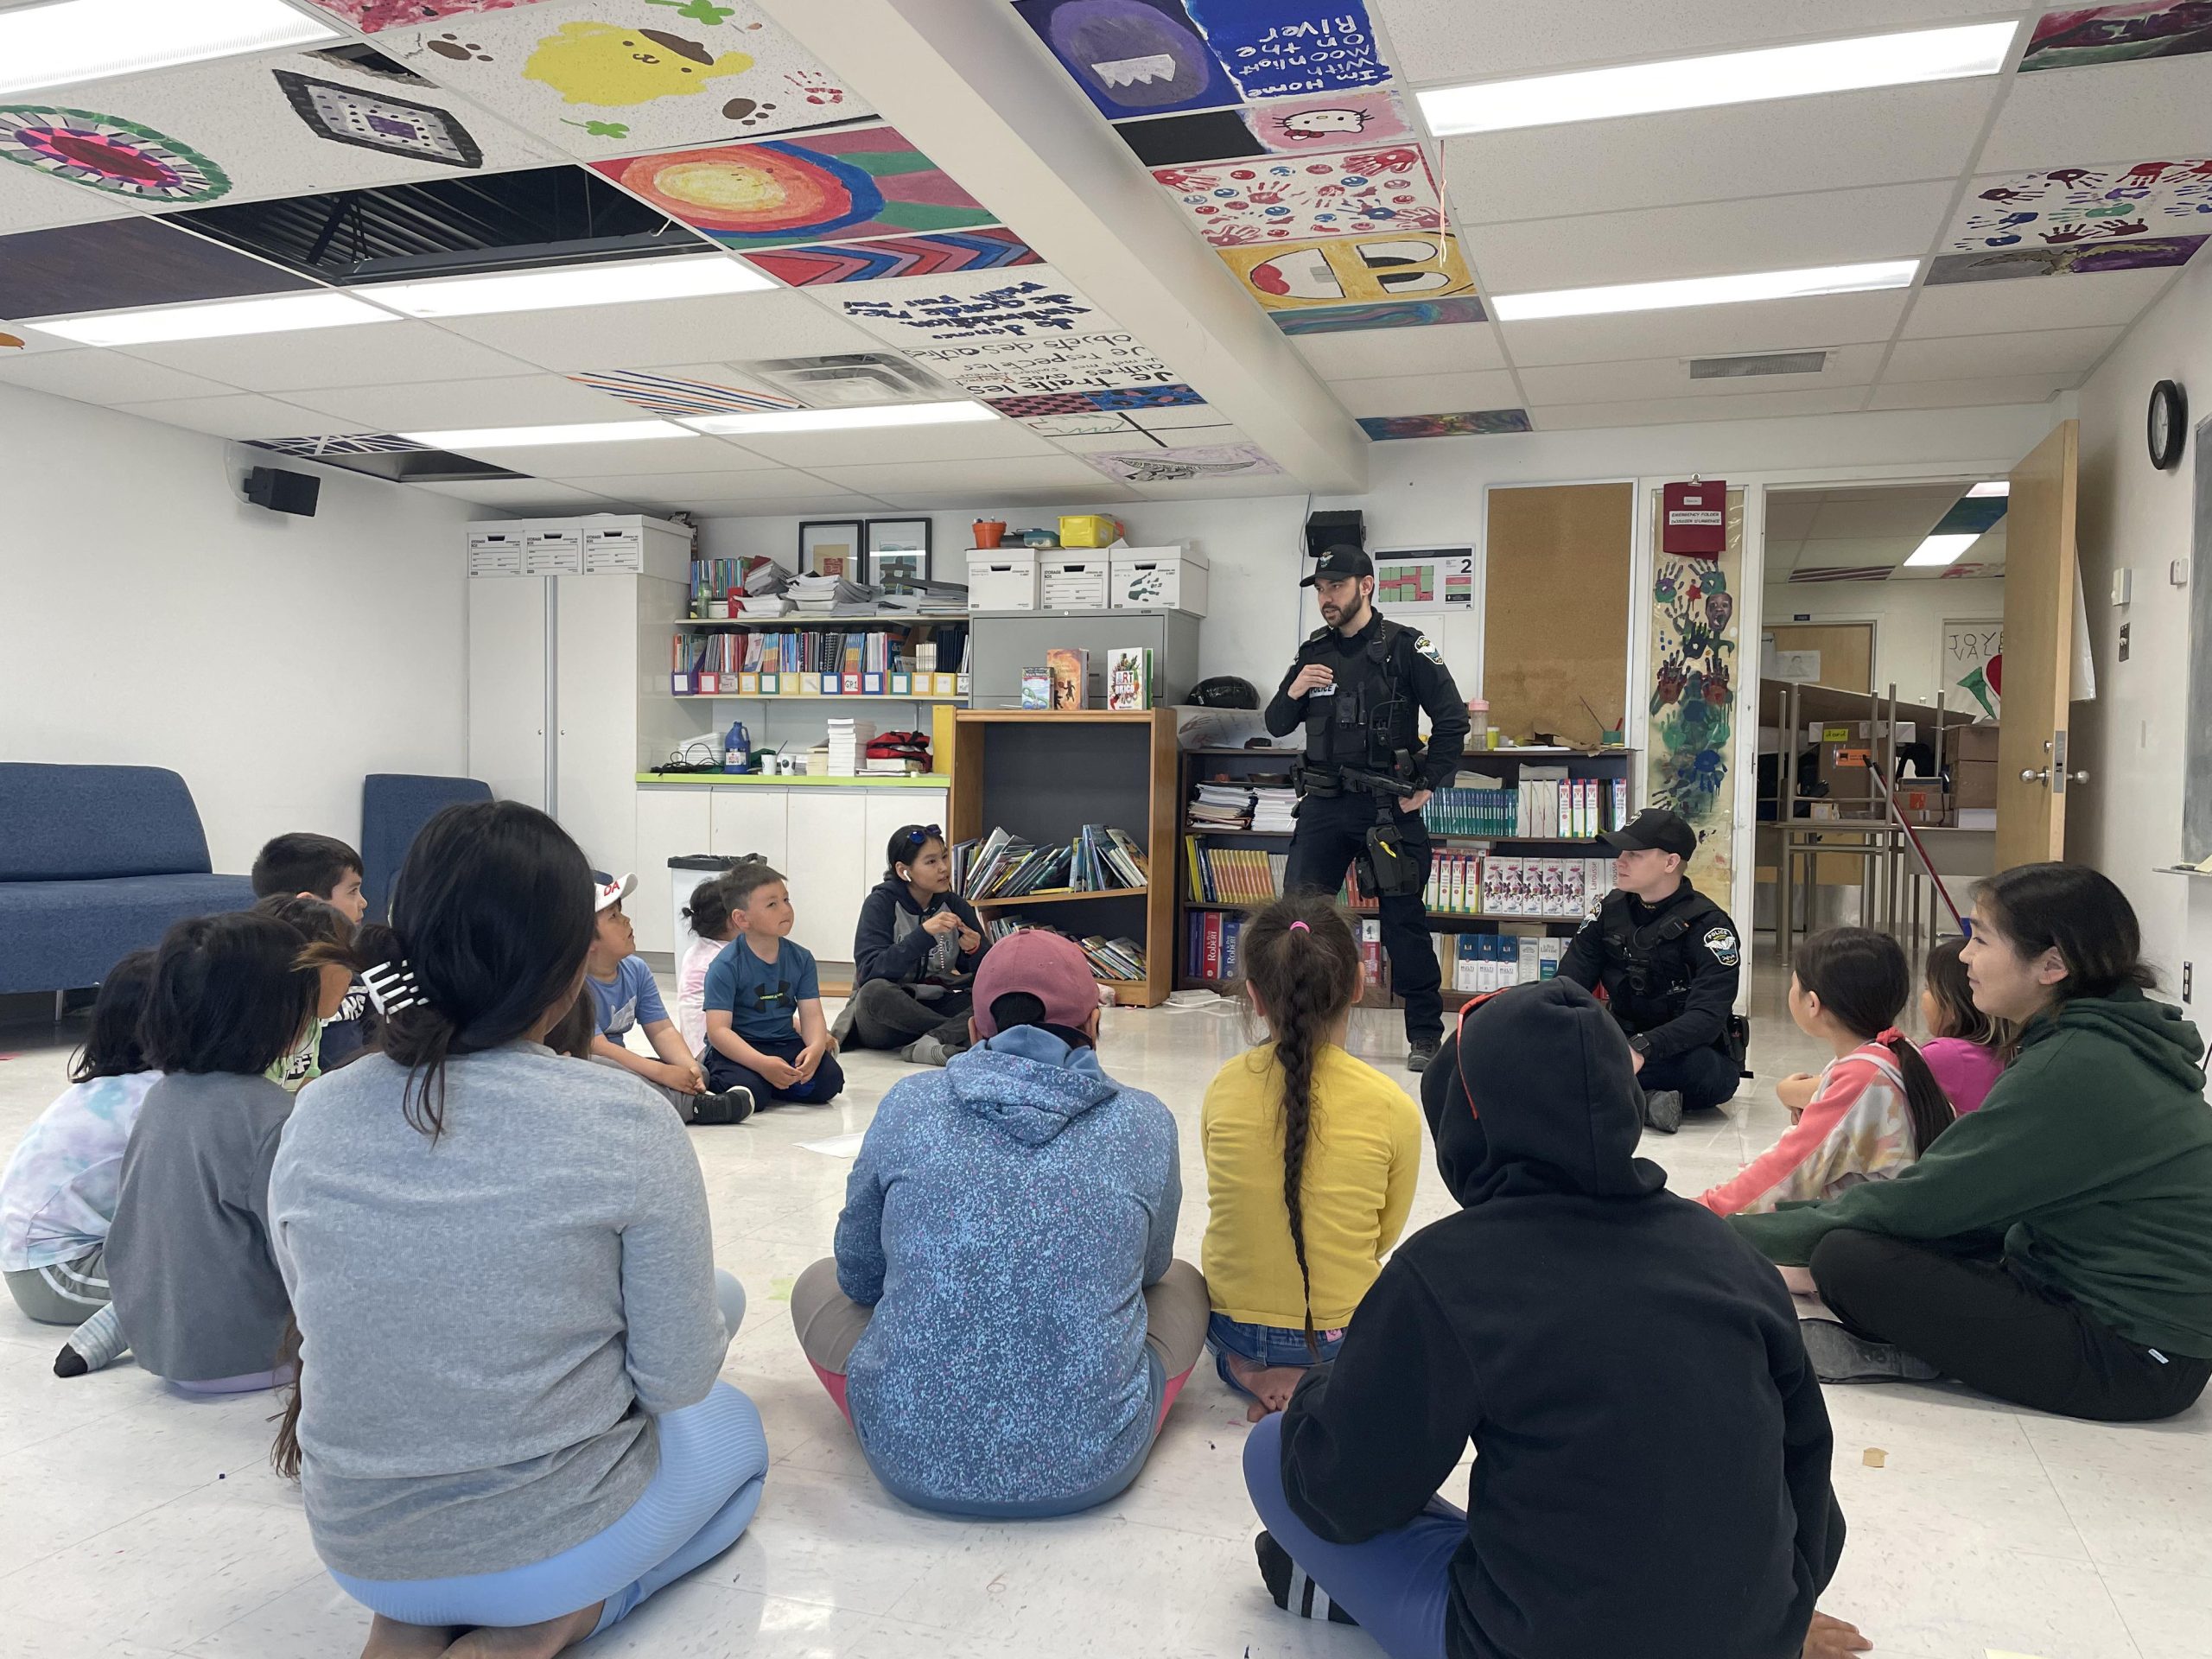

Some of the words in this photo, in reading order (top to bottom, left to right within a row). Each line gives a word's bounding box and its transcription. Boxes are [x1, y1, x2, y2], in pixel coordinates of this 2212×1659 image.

[1259, 15, 1357, 42] River
[1235, 42, 1301, 58] the
[1306, 57, 1375, 75] With
[1247, 79, 1324, 97] Home
[899, 347, 981, 361] autres
[980, 341, 1034, 355] des
[1109, 346, 1146, 357] Je
[963, 363, 1001, 372] les
[1001, 353, 1102, 371] respecte
[1019, 372, 1068, 382] avec
[1085, 364, 1165, 377] autres
[1130, 372, 1173, 382] Je
[965, 384, 1018, 395] les
[1018, 377, 1120, 392] traite
[1460, 558, 1471, 574] 2
[604, 880, 620, 896] DA
[1707, 930, 1728, 939] POLICE
